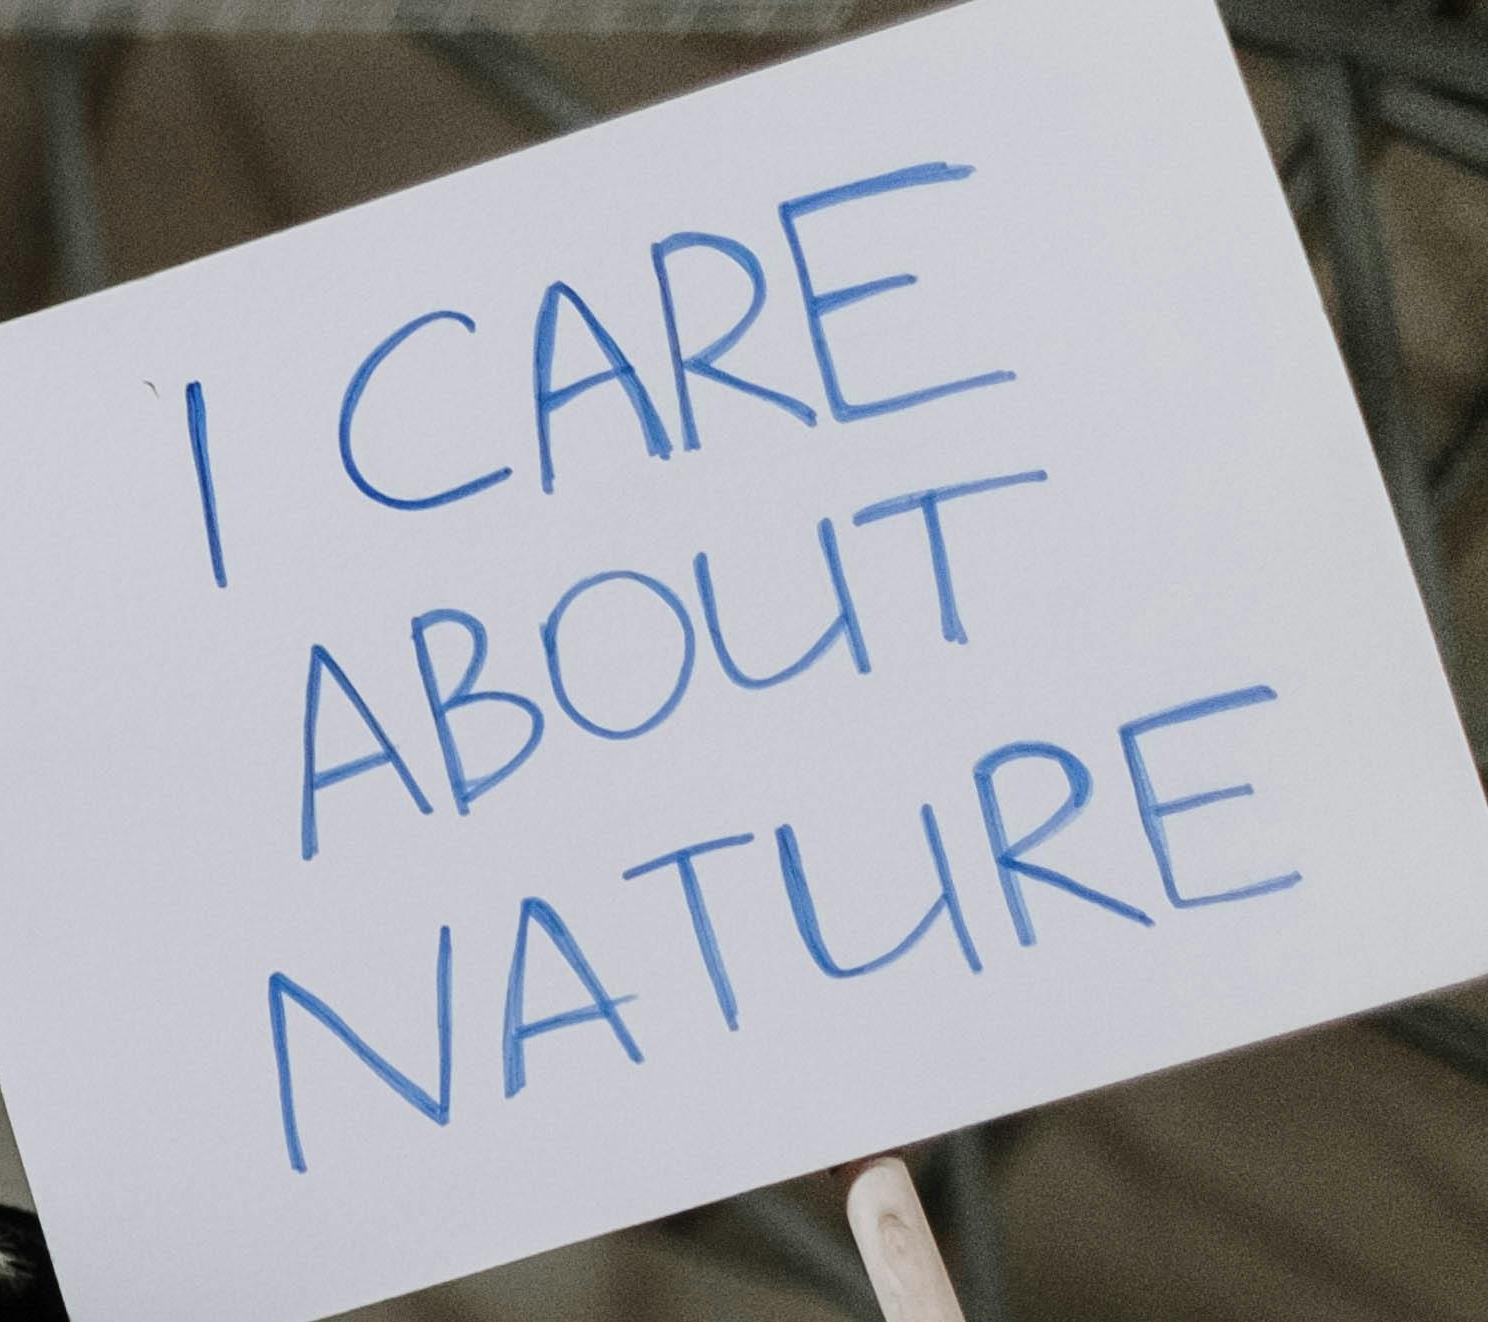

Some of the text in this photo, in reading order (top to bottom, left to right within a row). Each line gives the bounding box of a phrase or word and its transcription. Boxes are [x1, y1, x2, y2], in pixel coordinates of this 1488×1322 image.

[185, 161, 1018, 589] I CARE
[300, 469, 1048, 861] ABOUT
[268, 684, 1303, 1175] NATURE
